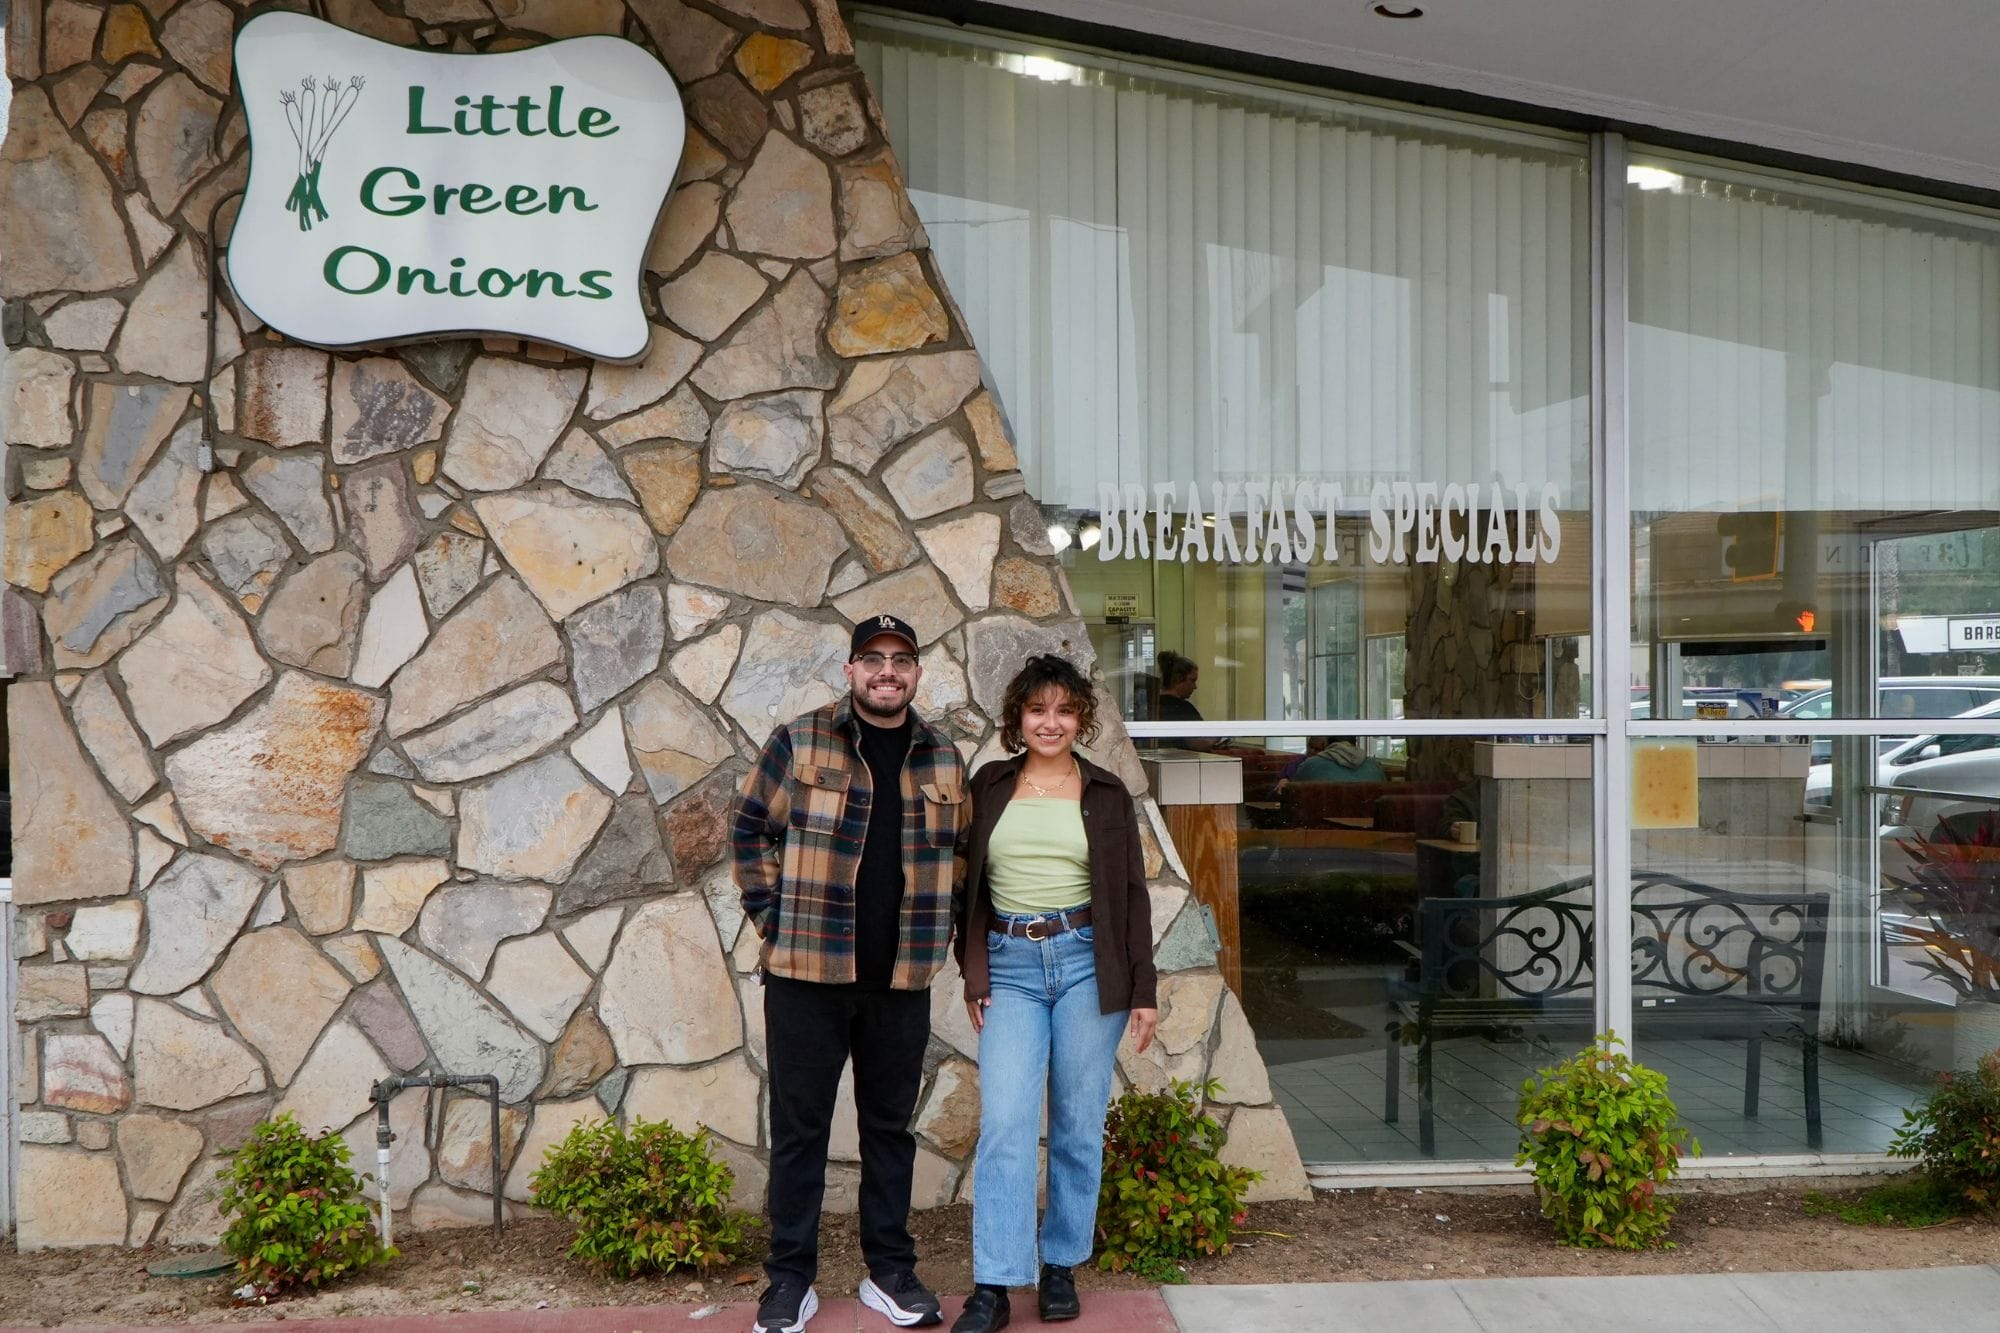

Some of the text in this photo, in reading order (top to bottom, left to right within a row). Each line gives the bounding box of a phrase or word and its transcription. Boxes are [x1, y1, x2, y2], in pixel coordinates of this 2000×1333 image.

[406, 85, 620, 138] Little
[359, 166, 599, 217] Green
[323, 245, 613, 300] Onions
[1098, 480, 1344, 564] BREAKFAST
[1368, 480, 1562, 565] SPECIALS
[878, 615, 895, 629] LA
